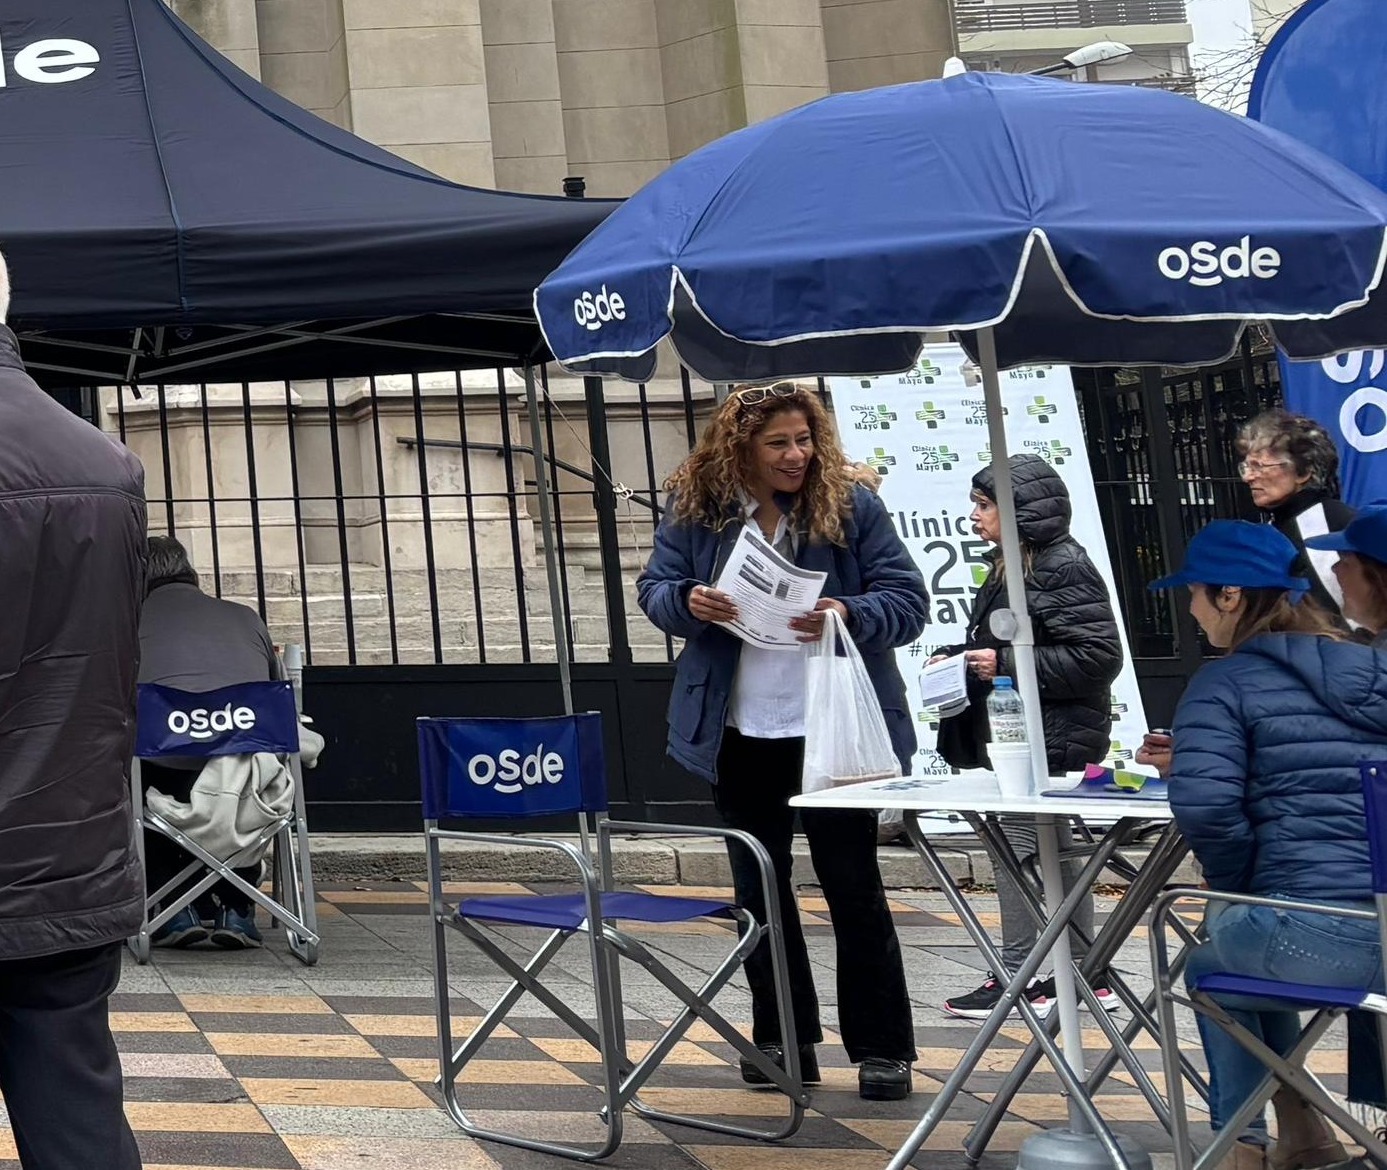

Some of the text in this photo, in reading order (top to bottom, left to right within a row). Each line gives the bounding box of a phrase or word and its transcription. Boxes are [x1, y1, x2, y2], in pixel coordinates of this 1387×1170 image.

[1158, 235, 1281, 287] osde
[574, 283, 626, 330] osde
[888, 510, 978, 539] línic
[168, 702, 256, 738] osde
[467, 743, 565, 793] osde
